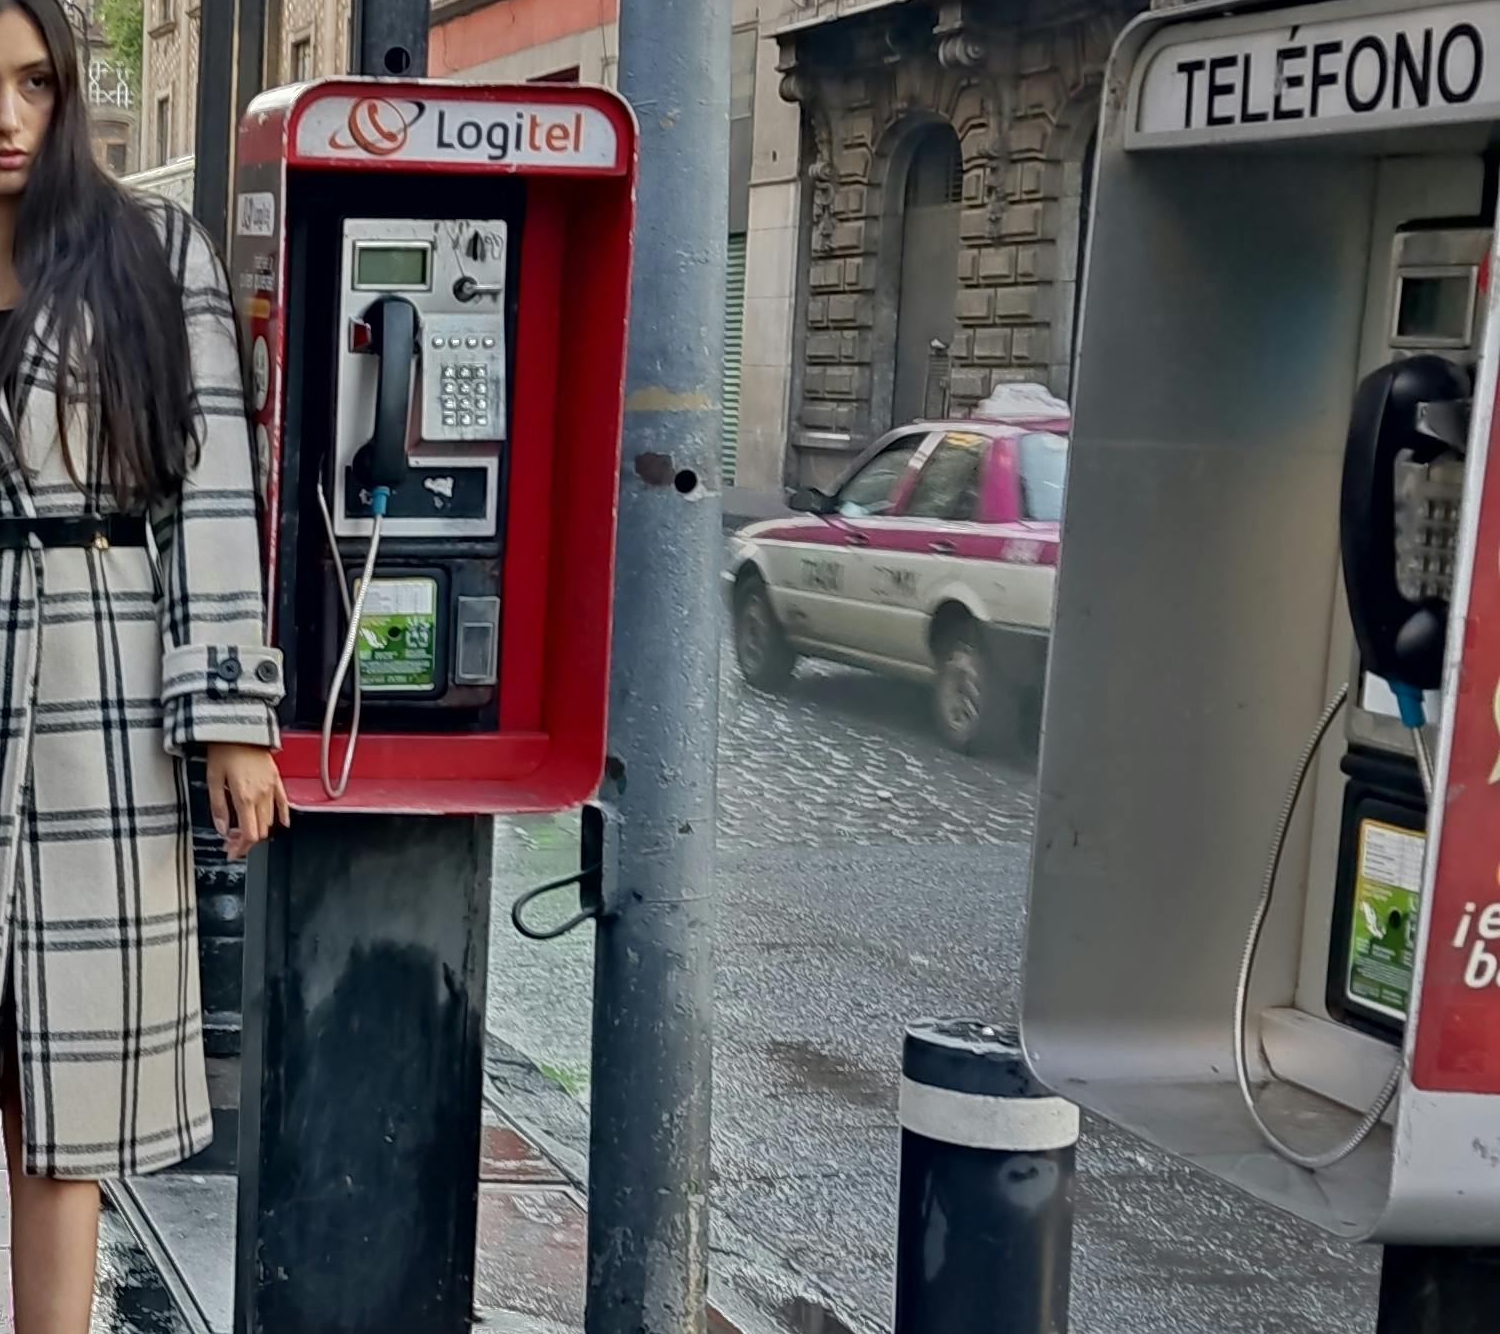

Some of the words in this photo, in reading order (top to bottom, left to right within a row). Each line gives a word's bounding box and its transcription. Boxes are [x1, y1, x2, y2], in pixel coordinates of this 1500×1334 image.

[1176, 22, 1484, 129] TELÉFONO
[436, 109, 583, 161] Logitel
[1464, 938, 1500, 989] b
